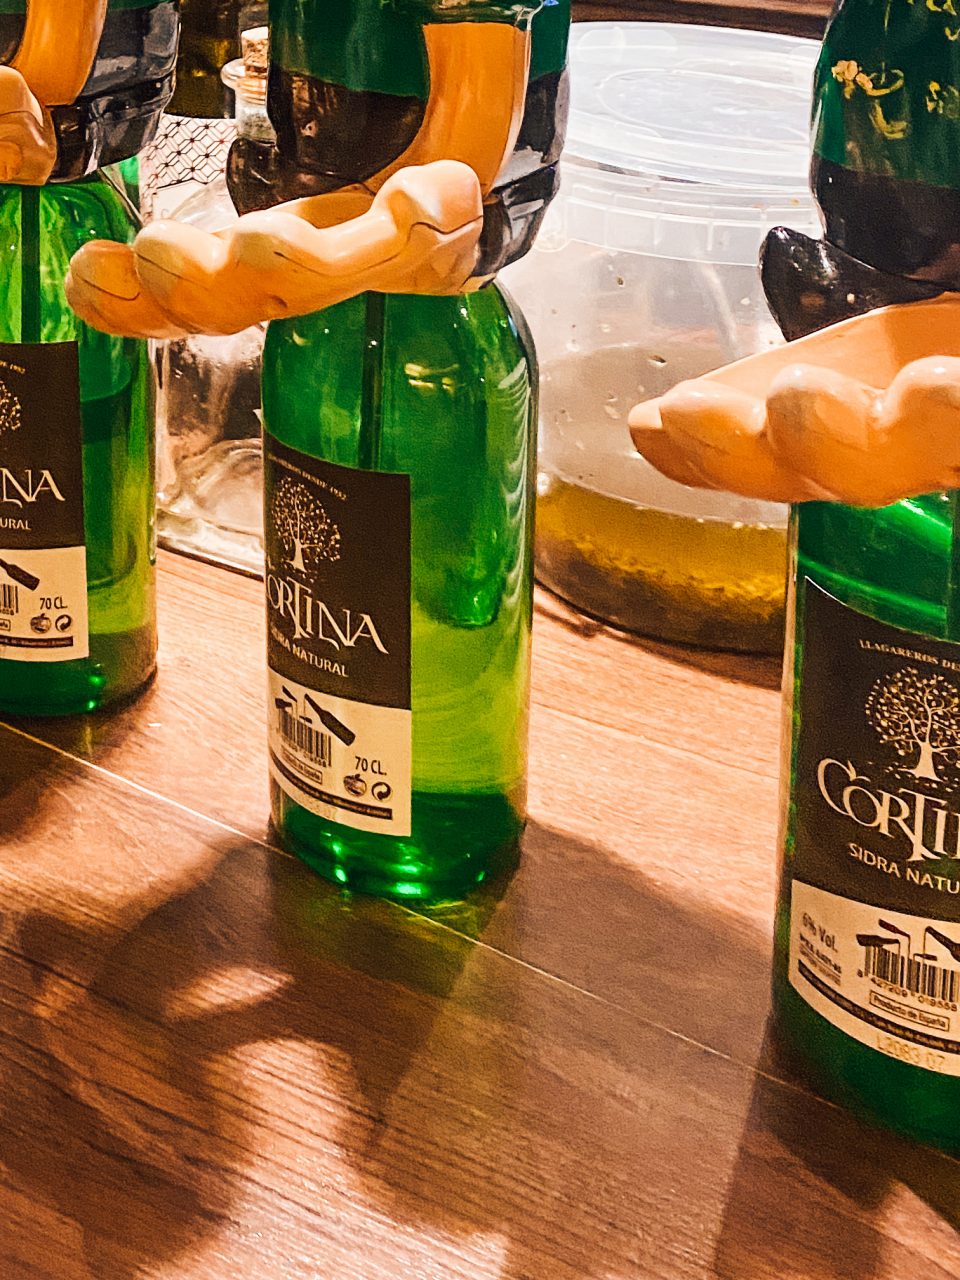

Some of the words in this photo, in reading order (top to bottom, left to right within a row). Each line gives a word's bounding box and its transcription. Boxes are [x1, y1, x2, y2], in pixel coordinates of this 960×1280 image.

[40, 597, 52, 610] 70
[267, 572, 389, 655] ORTINA
[292, 643, 349, 678] NATURAL
[355, 755, 368, 772] 70
[817, 758, 960, 862] CORTI
[847, 842, 902, 878] SIDRA
[906, 867, 960, 895] NATU
